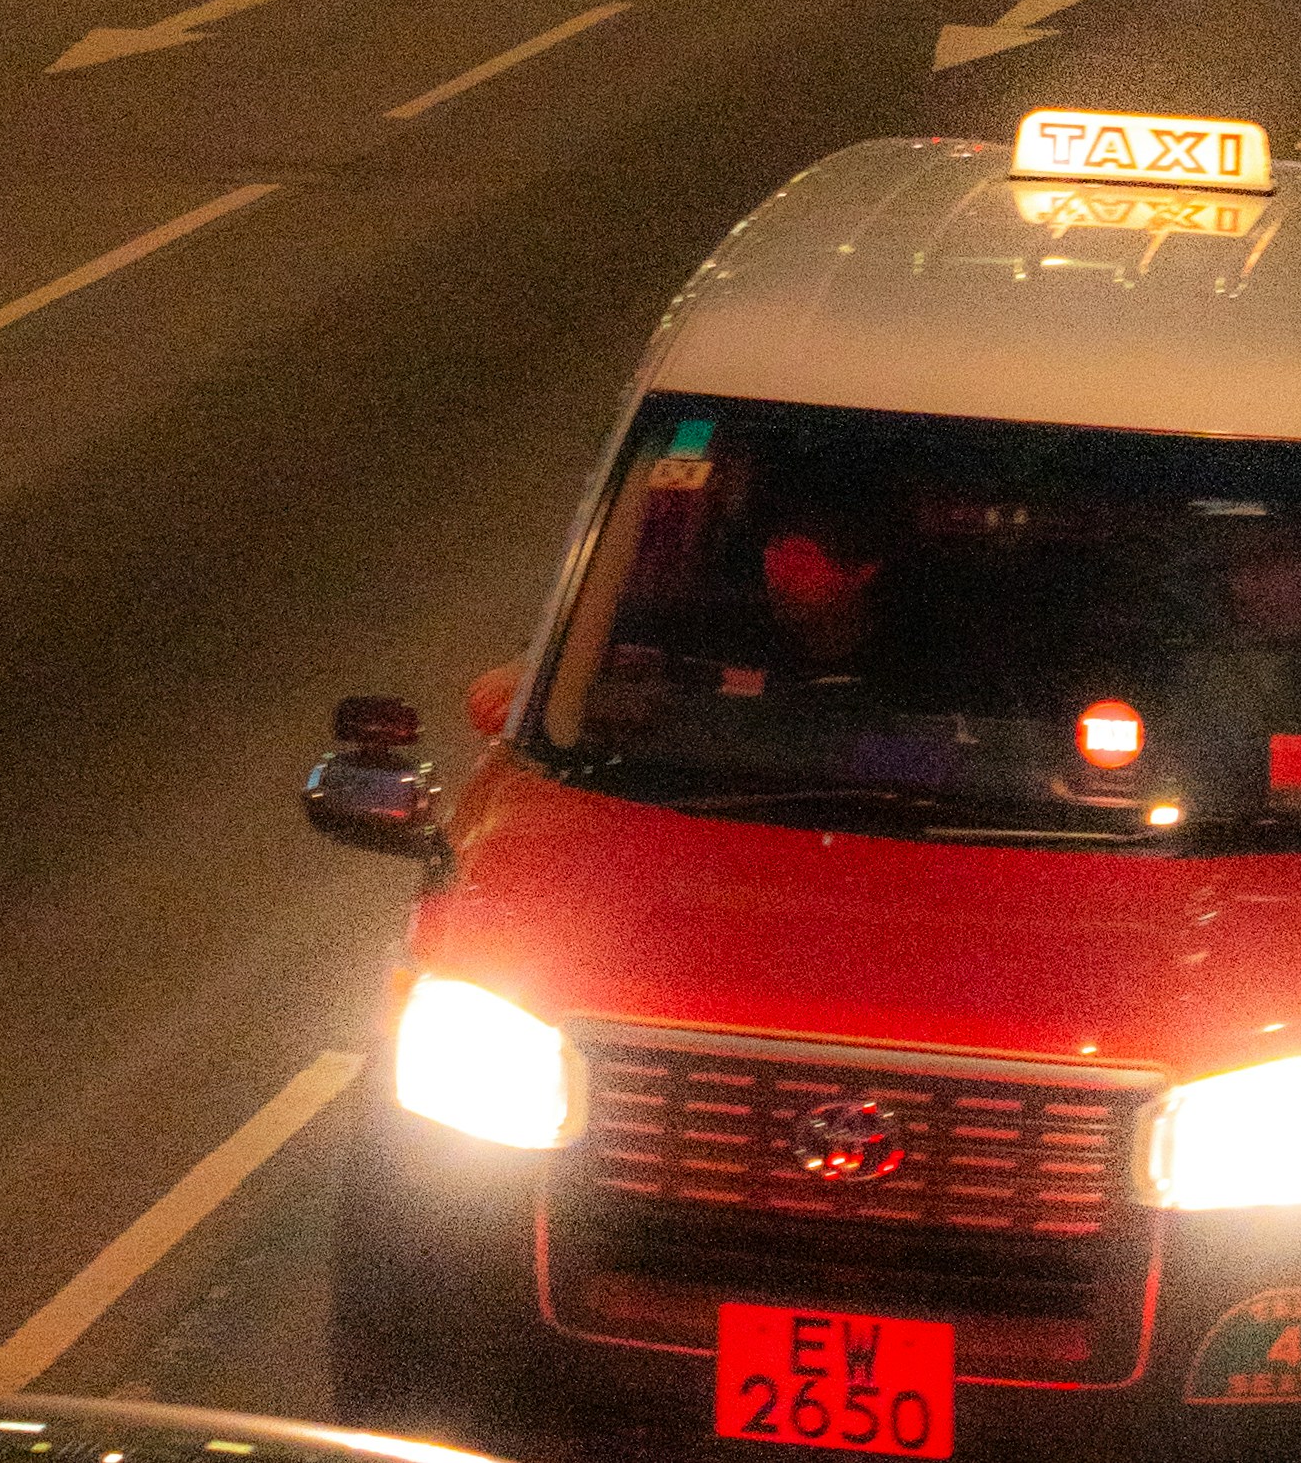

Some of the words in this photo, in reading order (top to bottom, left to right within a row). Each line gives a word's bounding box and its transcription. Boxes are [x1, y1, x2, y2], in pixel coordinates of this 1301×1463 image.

[1039, 122, 1242, 177] TAXI
[791, 1315, 881, 1380] EW
[741, 1374, 930, 1450] 2650
